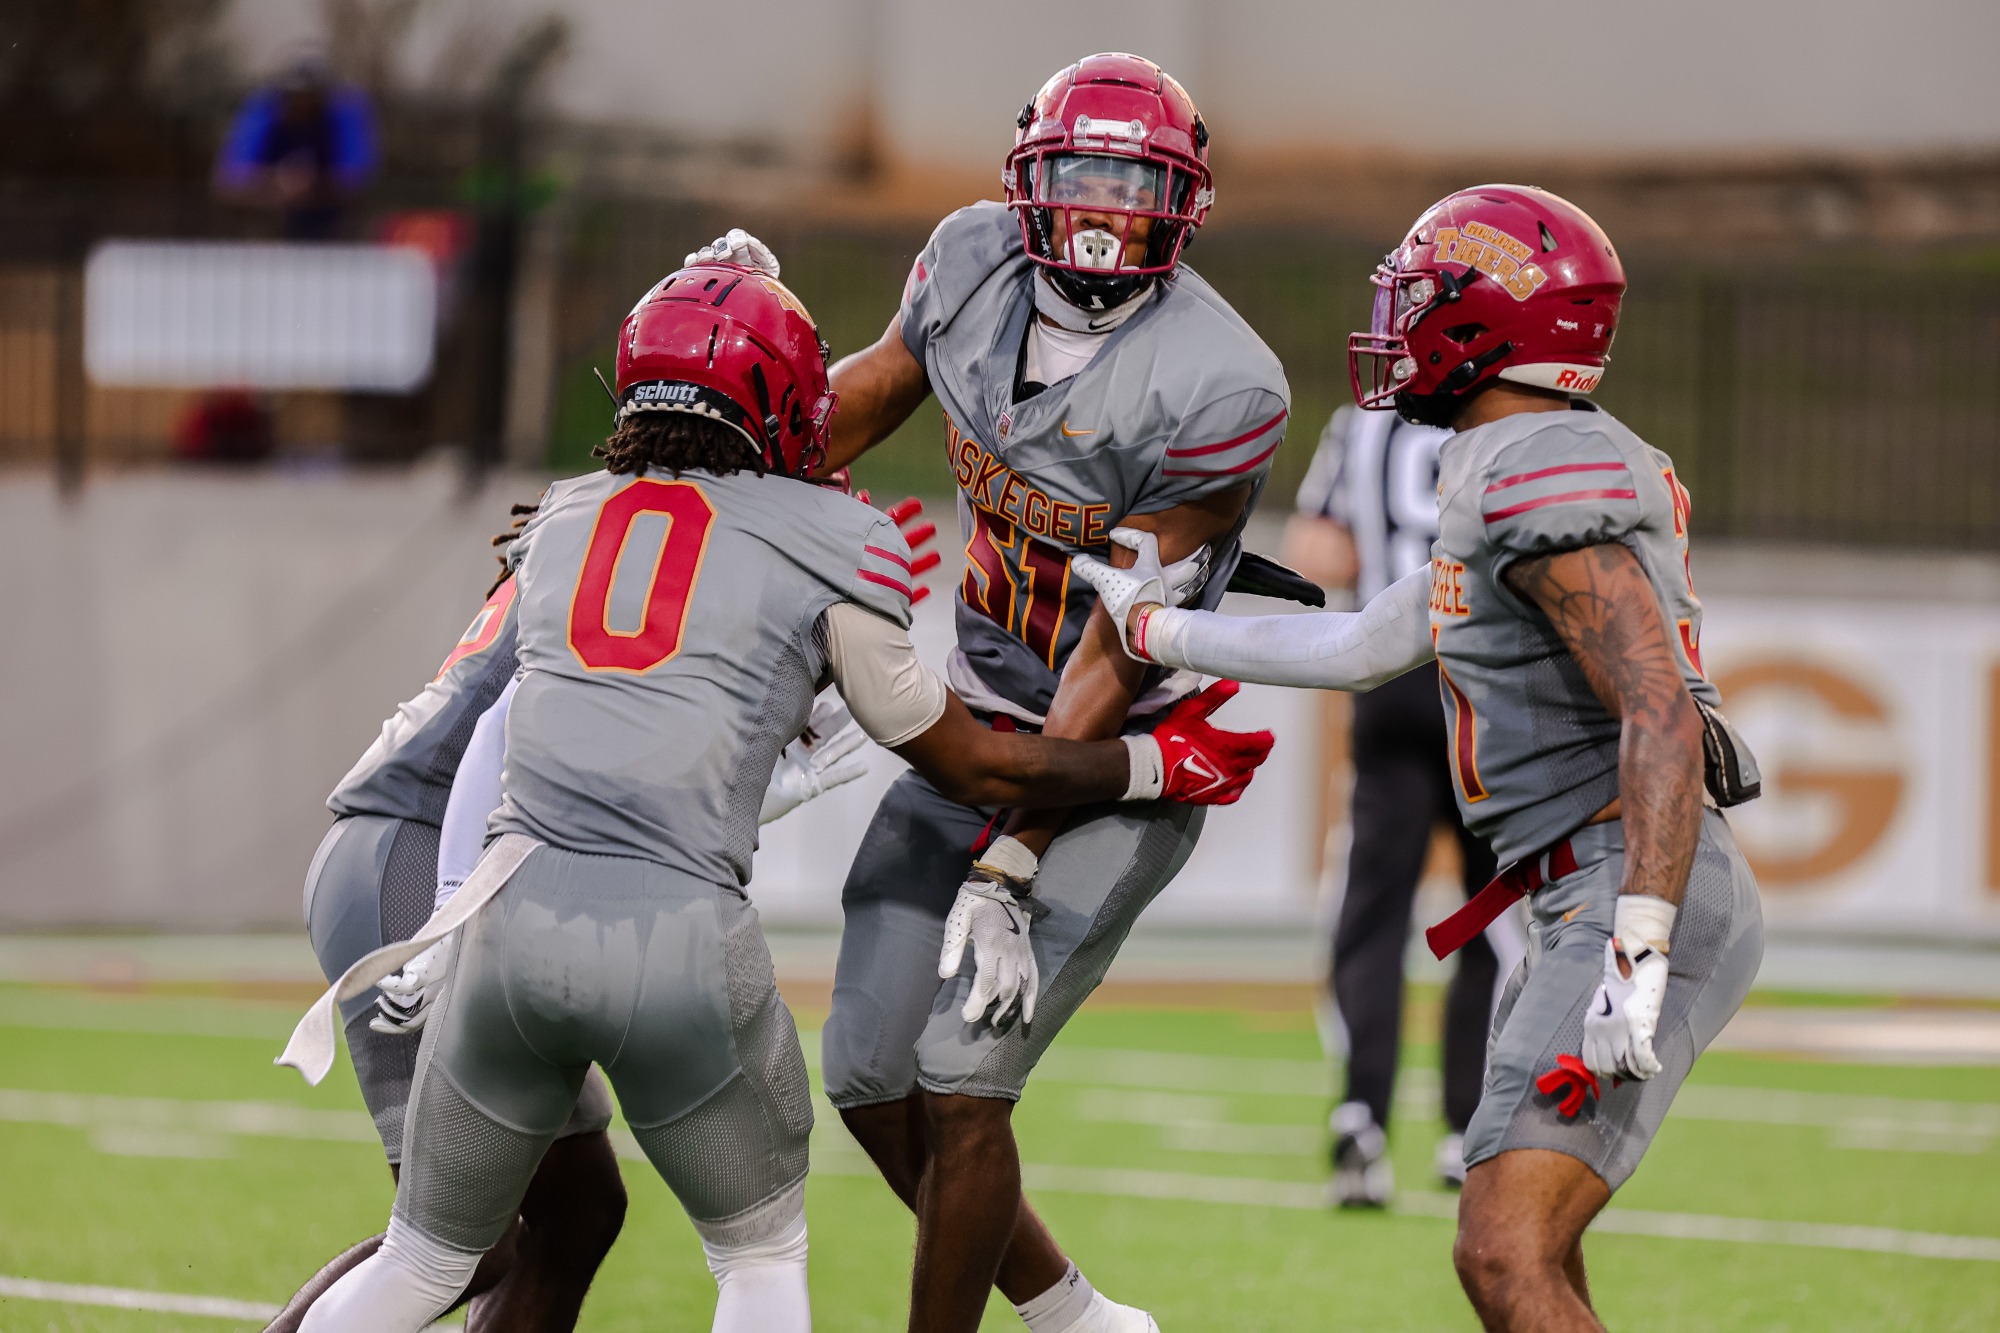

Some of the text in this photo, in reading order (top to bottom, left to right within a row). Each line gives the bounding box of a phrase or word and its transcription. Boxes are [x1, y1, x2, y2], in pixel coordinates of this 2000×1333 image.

[1434, 227, 1548, 301] TIGERS
[1463, 221, 1534, 264] GOLDEN
[635, 380, 699, 402] schutt
[943, 408, 1110, 546] USKEGEE
[566, 477, 718, 676] 0
